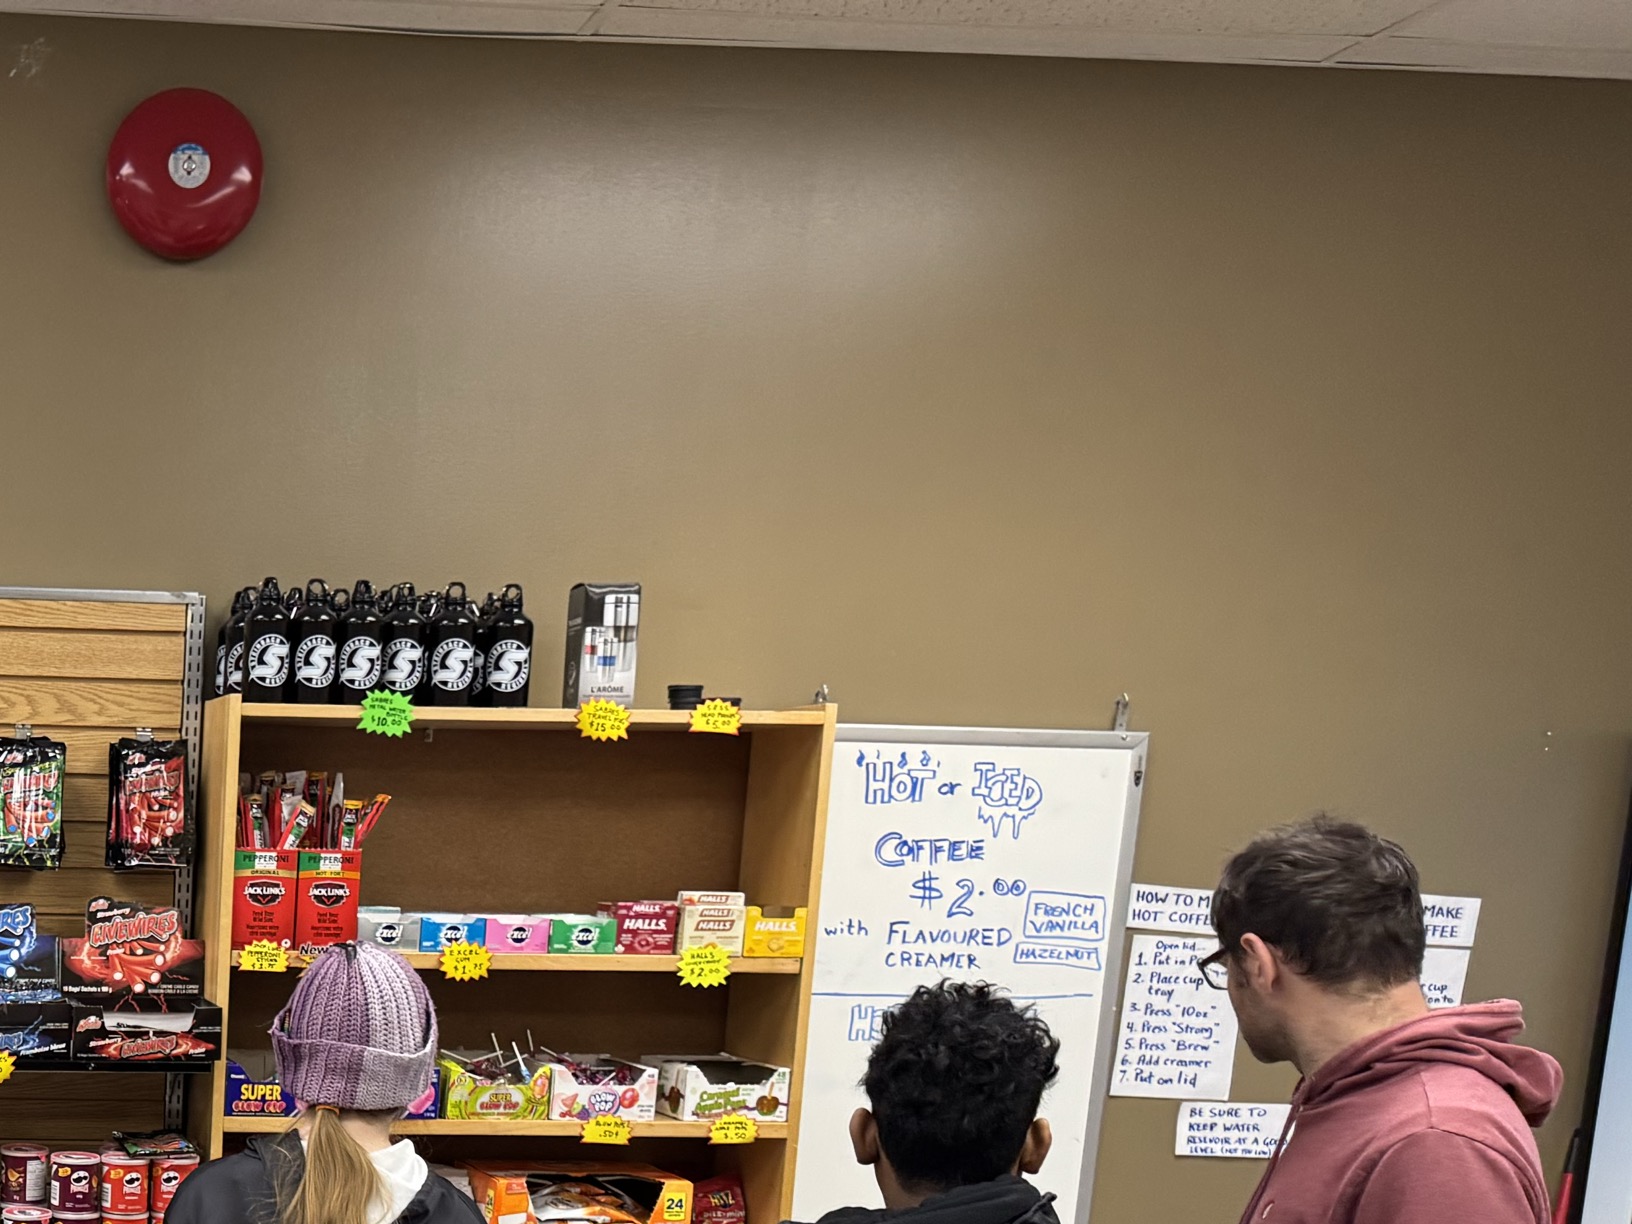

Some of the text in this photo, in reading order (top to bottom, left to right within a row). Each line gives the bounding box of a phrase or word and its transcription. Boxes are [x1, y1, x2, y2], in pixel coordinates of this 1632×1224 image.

[865, 760, 1043, 812] HOT or ICED
[875, 832, 986, 868] COFFEE
[242, 853, 290, 864] PEPPERONI
[307, 855, 354, 866] PEPPERONI
[1136, 889, 1169, 904] HOW
[1173, 893, 1194, 907] TO
[632, 903, 662, 913] HALLS
[1033, 902, 1095, 918] FRENCH
[1424, 904, 1465, 920] MAKE
[623, 918, 667, 930] HALLS
[1132, 908, 1212, 926] HOT COFFE
[824, 918, 1013, 948] with FLAVOURED
[1029, 919, 1101, 935] VANILLA
[1425, 924, 1460, 938] FFEE
[1155, 940, 1180, 952] Open
[884, 951, 982, 970] CREAMER
[1019, 947, 1097, 962] HAZELNUT
[1135, 952, 1147, 966] 1.
[1153, 951, 1171, 966] Put
[1132, 971, 1204, 991] 2. Place cup
[1147, 985, 1174, 1003] tray
[1428, 983, 1448, 995] cup
[1144, 1002, 1172, 1017] Press
[1126, 1021, 1138, 1033] 4.
[1141, 1020, 1168, 1033] Press
[1138, 1037, 1167, 1051] Press
[1136, 1054, 1160, 1067] Add
[1163, 1058, 1212, 1068] creamer
[1134, 1067, 1155, 1084] Put
[1157, 1077, 1173, 1085] on
[1177, 1070, 1198, 1088] lid
[240, 1084, 282, 1101] SUPER
[489, 1093, 512, 1104] SUPER
[1189, 1107, 1268, 1118] BE SURE TO
[1188, 1122, 1261, 1133] KEEP WATER
[1251, 1137, 1260, 1145] A
[666, 1198, 684, 1211] 24
